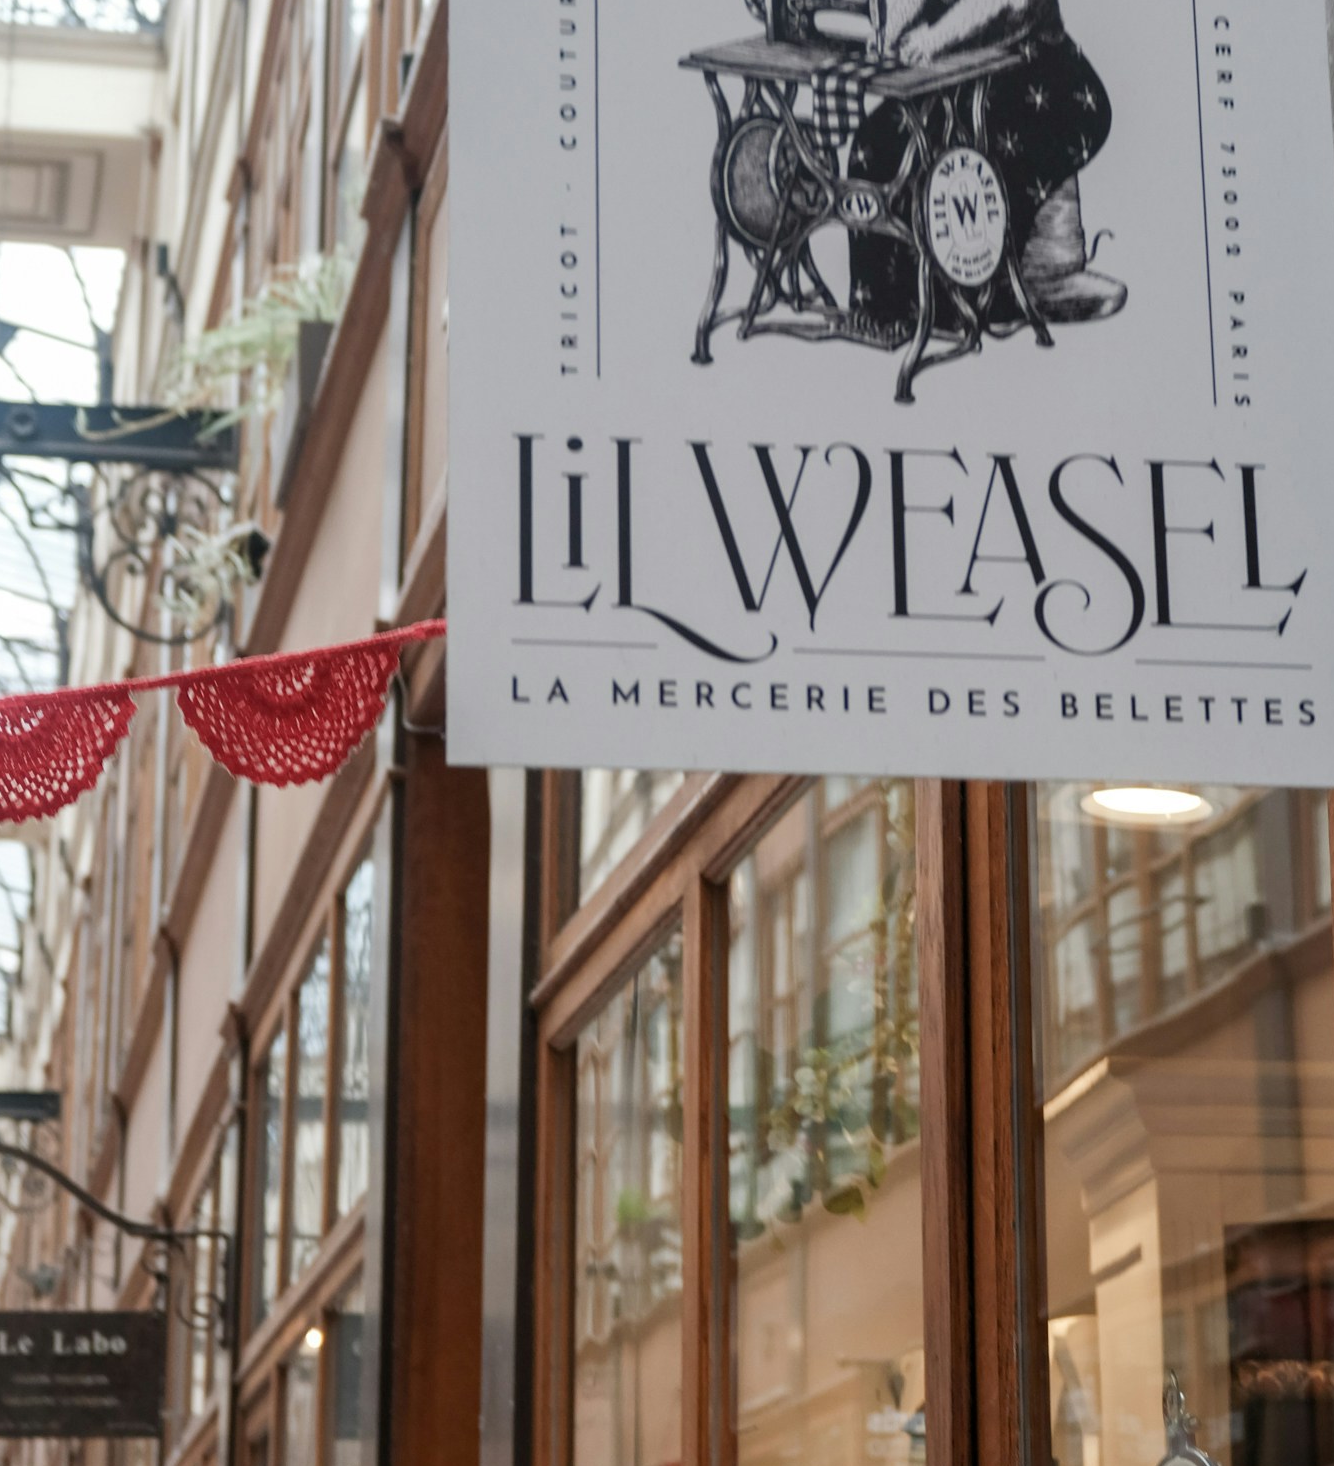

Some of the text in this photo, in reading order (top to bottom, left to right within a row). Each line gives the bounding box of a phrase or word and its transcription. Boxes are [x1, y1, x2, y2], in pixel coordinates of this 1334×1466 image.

[1213, 15, 1234, 111] CERF
[1220, 143, 1241, 258] 75002
[560, 224, 578, 377] TRICOT
[1228, 291, 1251, 408] PARIS
[689, 441, 1309, 656] WEASEL
[511, 676, 1320, 727] LA MERCERIE DES BELETTES
[53, 1329, 127, 1355] Labo
